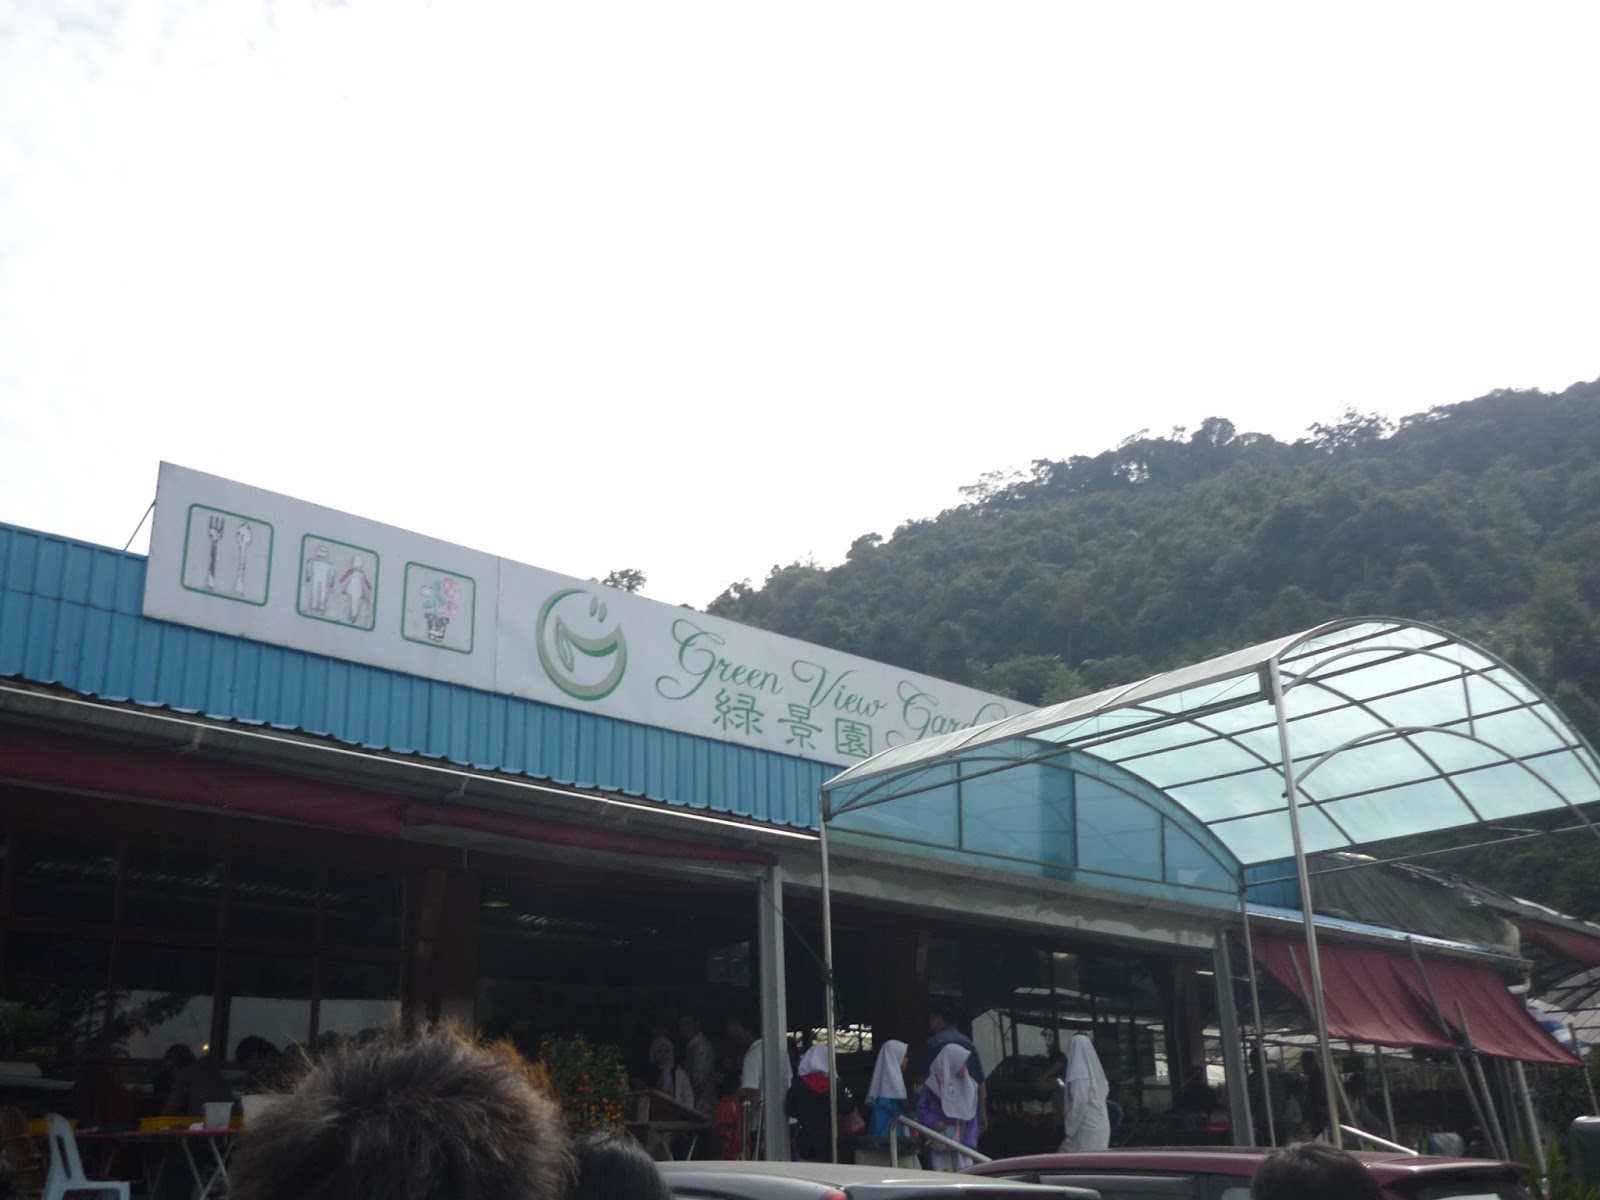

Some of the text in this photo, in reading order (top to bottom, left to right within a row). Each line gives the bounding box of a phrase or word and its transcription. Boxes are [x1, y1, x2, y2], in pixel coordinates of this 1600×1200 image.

[656, 619, 1008, 747] Green View Gard
